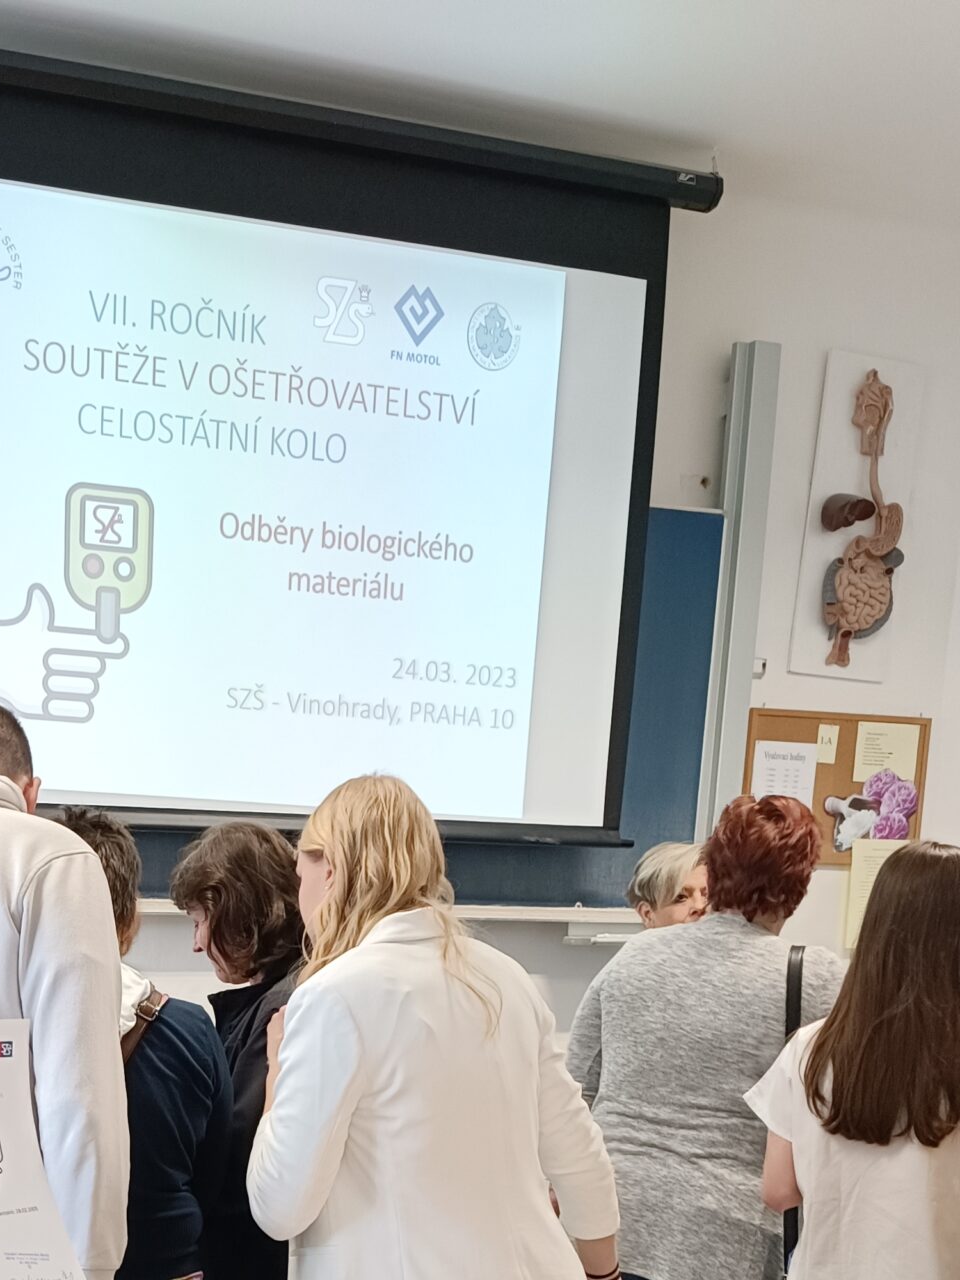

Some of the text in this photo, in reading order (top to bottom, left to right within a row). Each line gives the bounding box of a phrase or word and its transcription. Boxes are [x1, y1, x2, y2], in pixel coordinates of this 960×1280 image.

[1, 235, 23, 290] SESTER
[89, 290, 267, 346] VII. ROČNÍK
[23, 339, 481, 426] SOUTĚŽE V OŠETŘOVATELSTVÍ
[390, 350, 441, 367] FN MOTOL
[78, 402, 348, 464] CELOSTÁTNÍ KOLO
[219, 512, 475, 564] Odběry biologického
[287, 571, 405, 602] materiálu
[391, 657, 518, 689] 24.03. 2023
[226, 683, 265, 711] SZŠ
[287, 692, 401, 726] Vinohrady,
[410, 701, 482, 728] PRAHA
[489, 707, 515, 730] 10
